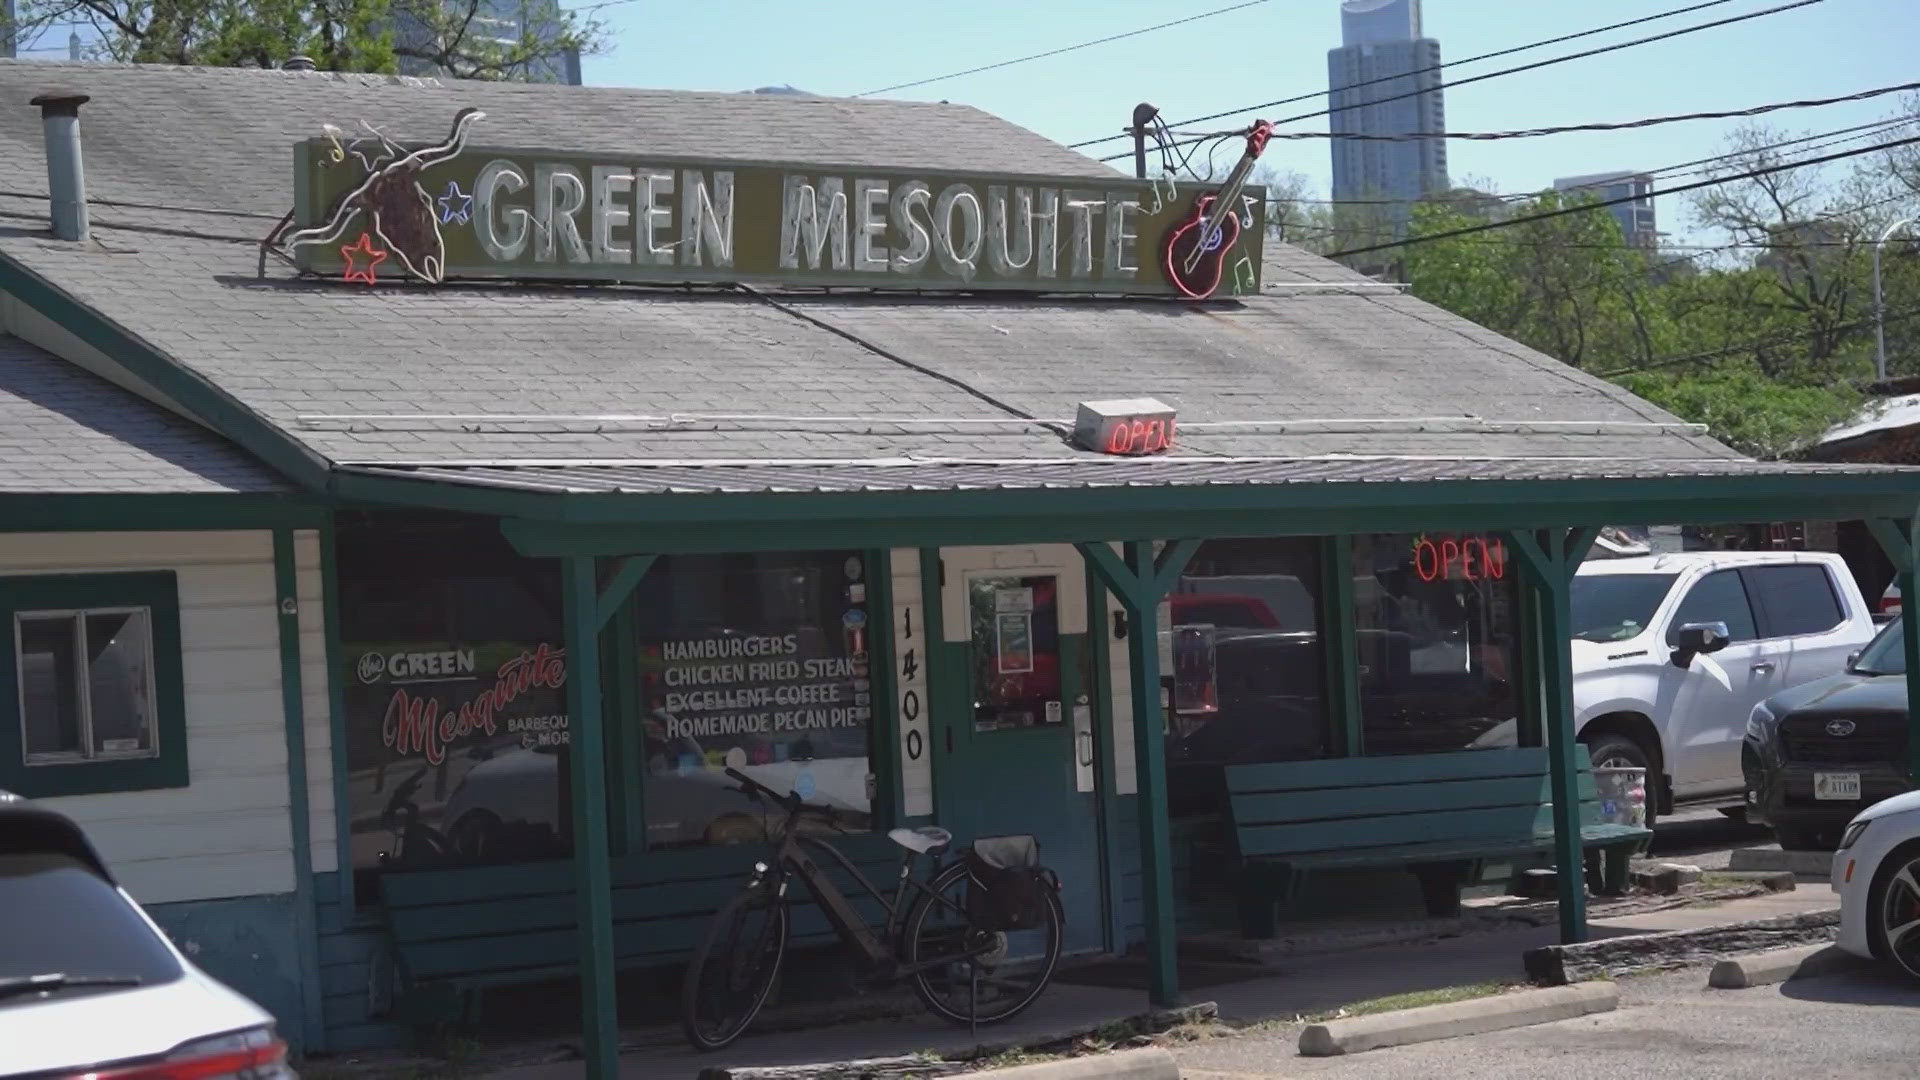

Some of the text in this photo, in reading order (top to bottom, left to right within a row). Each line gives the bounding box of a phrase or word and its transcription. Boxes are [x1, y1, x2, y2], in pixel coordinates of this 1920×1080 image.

[473, 159, 1140, 284] GREEN MESQUITE
[1109, 419, 1176, 454] OPEN
[1416, 538, 1504, 582] OPEN
[663, 634, 797, 661] HAMBURGERS
[388, 650, 475, 677] GREEN
[664, 658, 856, 687] CHICKEN FRIED STEAK
[665, 683, 840, 712] EXCELLENT COFFEE
[902, 607, 923, 760] 1400
[383, 643, 567, 766] Mesquite
[507, 715, 568, 732] BARBEQU
[667, 707, 857, 739] HOMEMADE PECAN PIE
[538, 731, 570, 746] MOR
